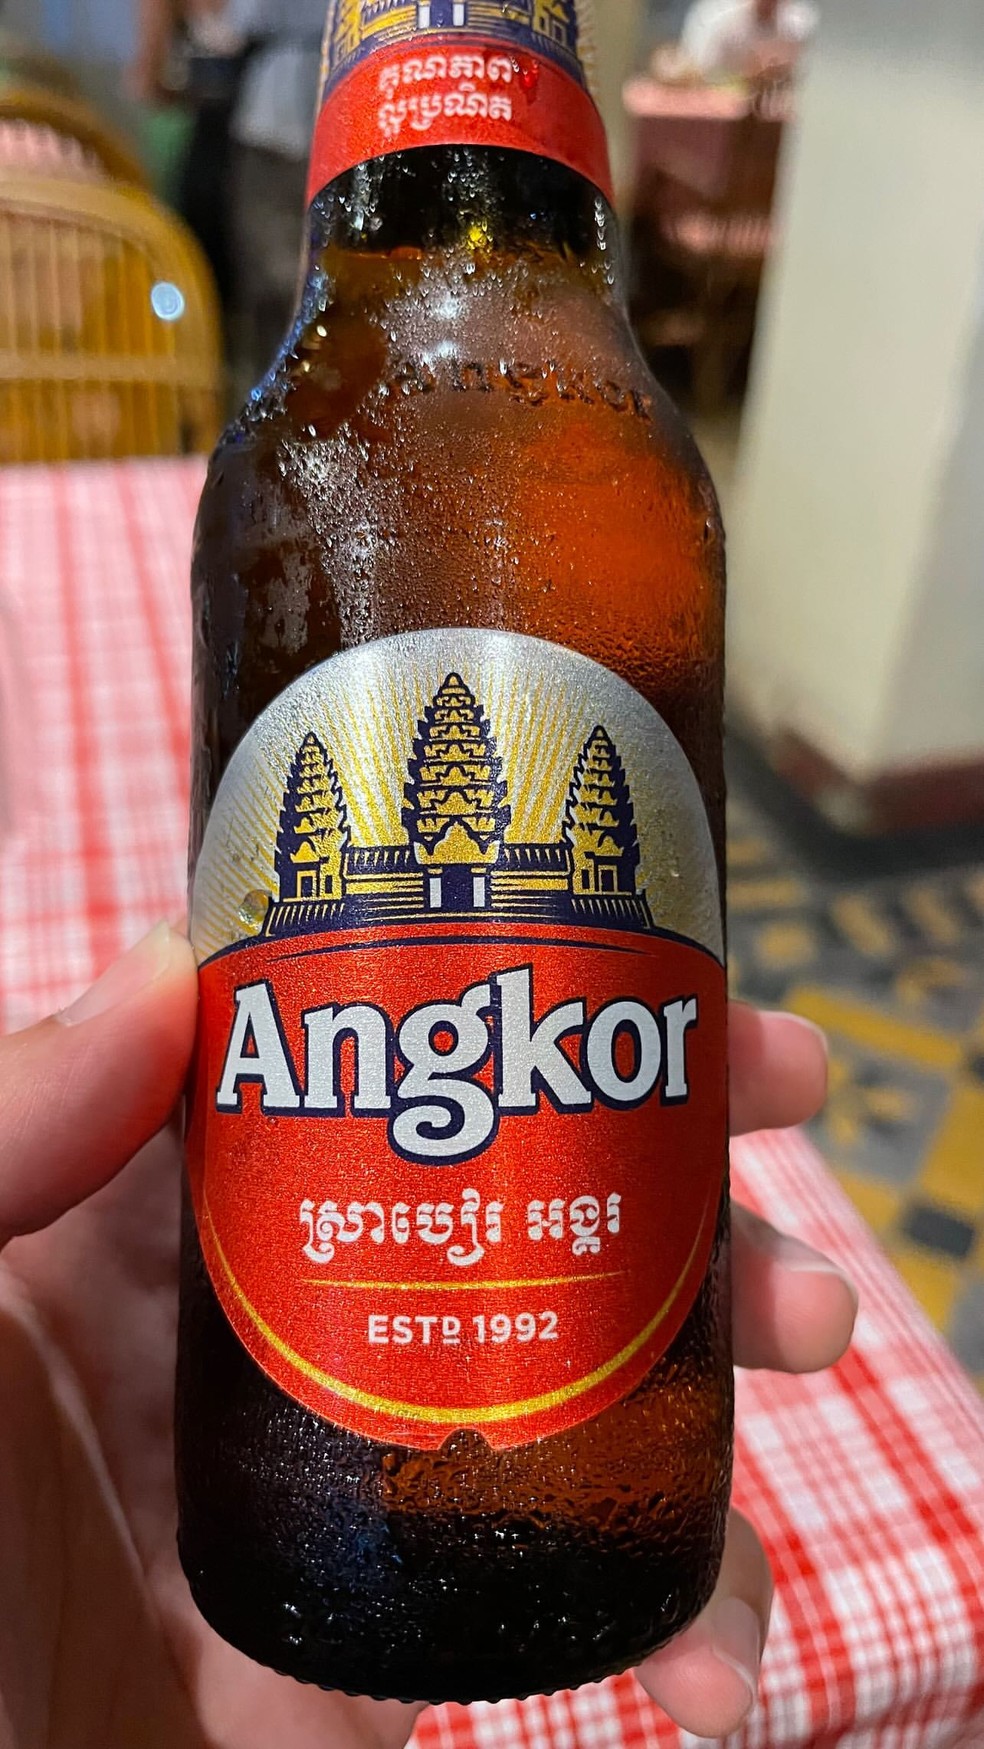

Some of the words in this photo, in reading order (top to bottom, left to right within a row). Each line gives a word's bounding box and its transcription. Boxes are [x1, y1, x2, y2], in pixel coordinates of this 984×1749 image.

[378, 55, 513, 97] គុណភាព
[217, 968, 697, 1164] Angkor
[526, 1192, 622, 1256] អង្គរ
[473, 1310, 559, 1343] 1992
